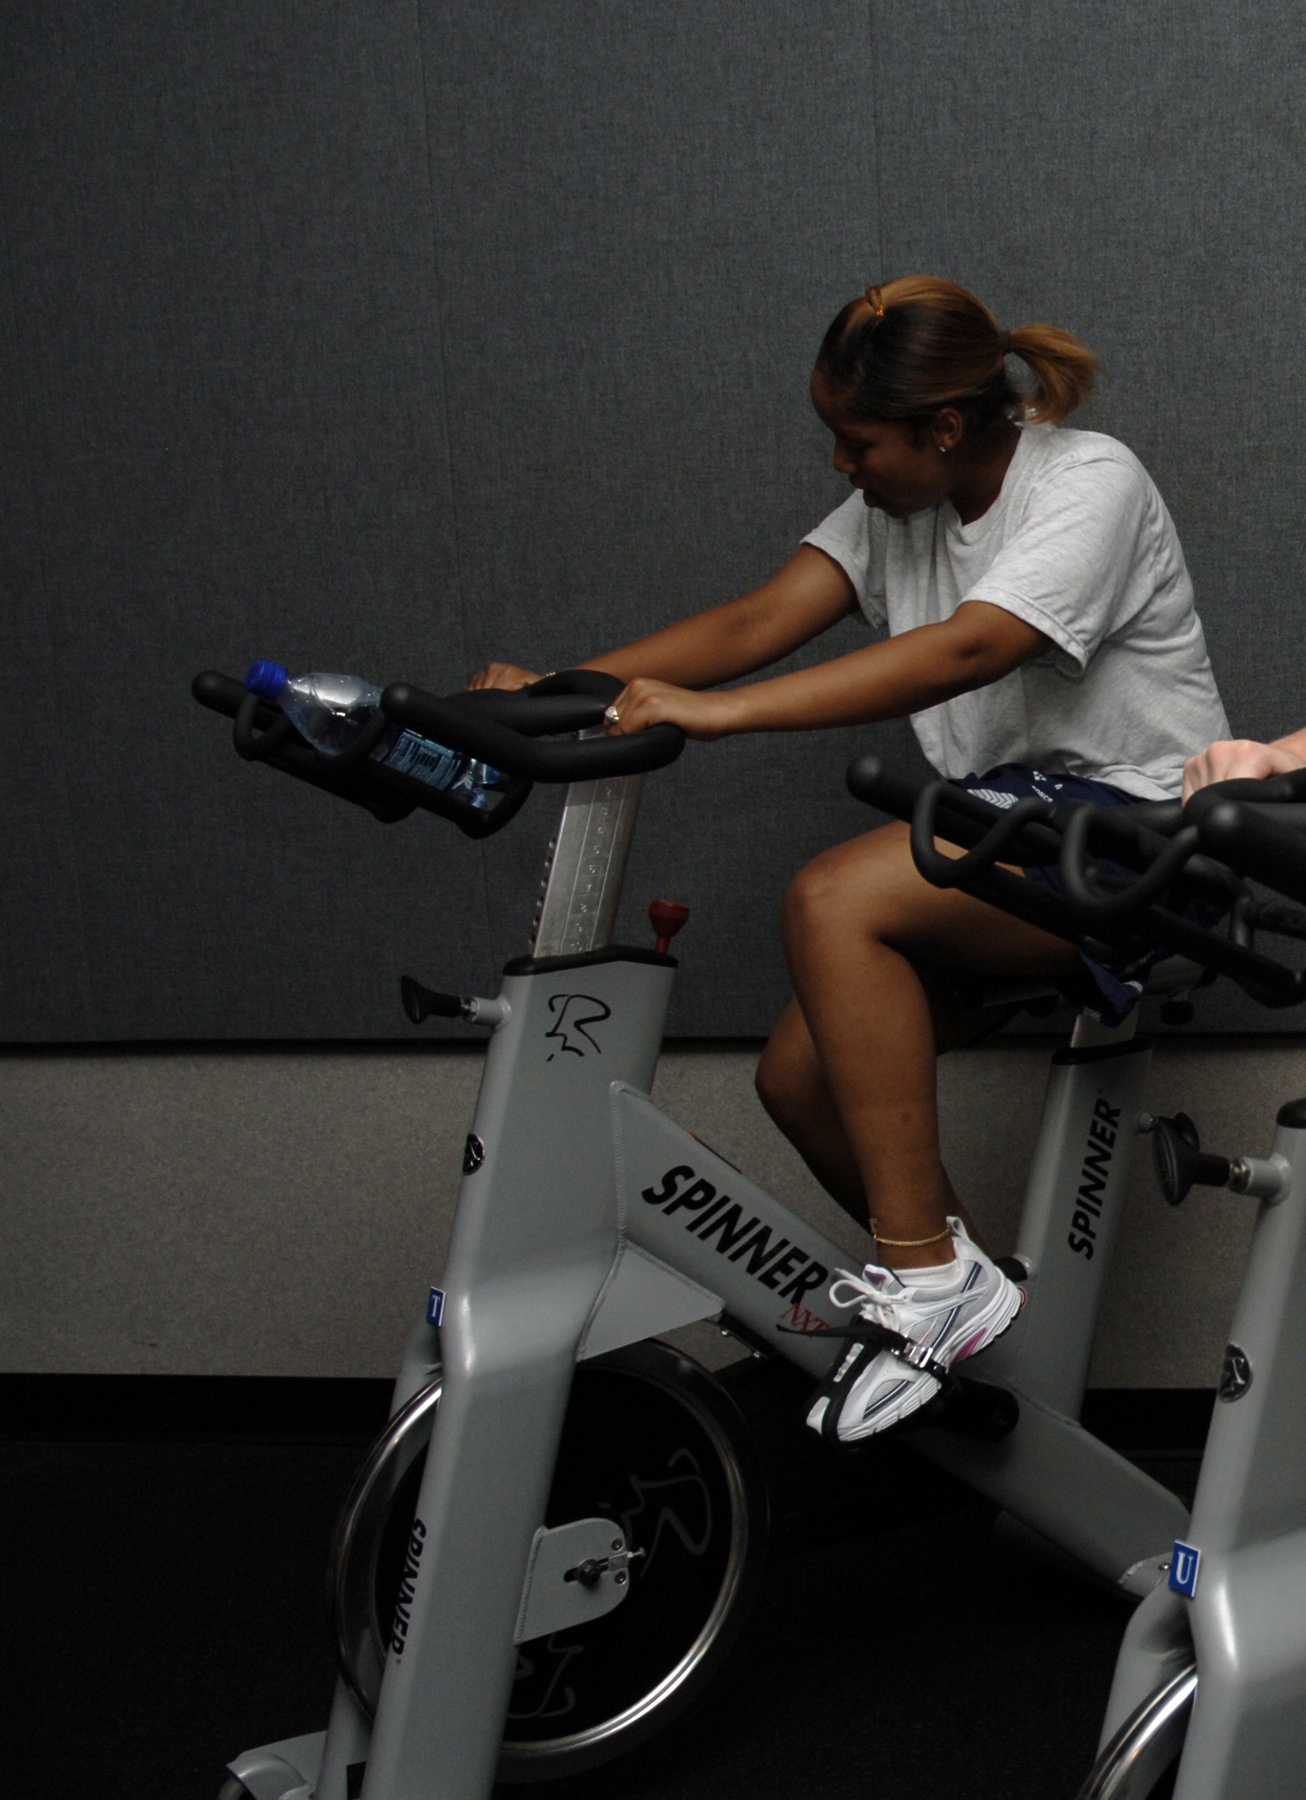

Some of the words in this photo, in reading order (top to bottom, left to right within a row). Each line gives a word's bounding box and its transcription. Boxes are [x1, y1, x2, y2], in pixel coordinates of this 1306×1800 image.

[1068, 1098, 1121, 1260] SPINNER
[641, 1165, 829, 1303] SPINNER
[430, 1293, 441, 1319] T
[1177, 1552, 1194, 1584] U
